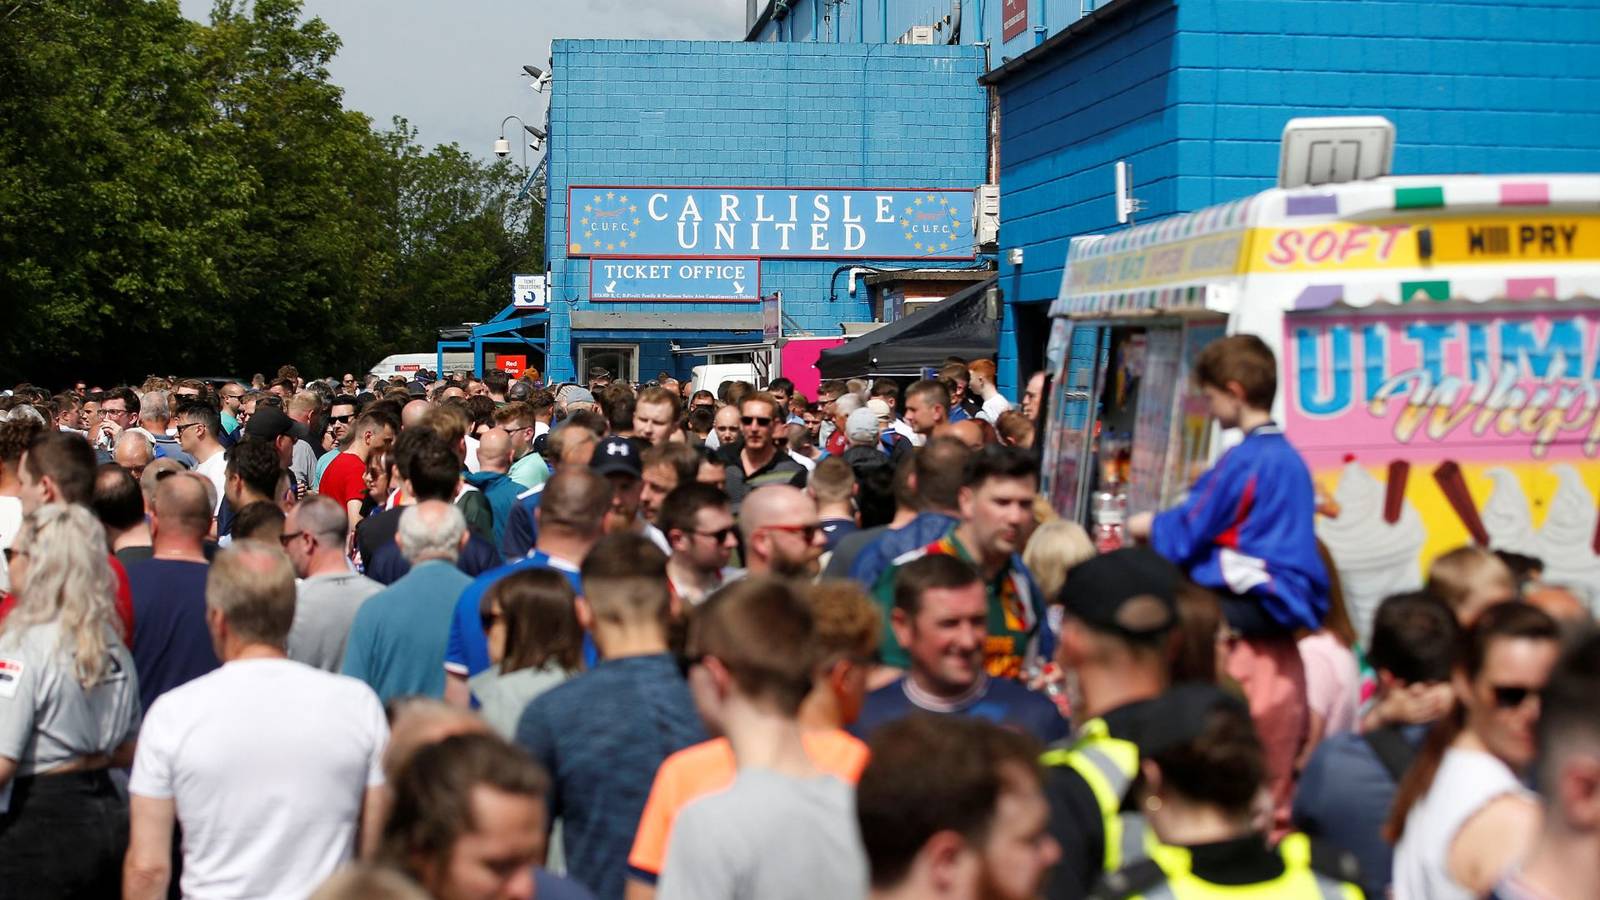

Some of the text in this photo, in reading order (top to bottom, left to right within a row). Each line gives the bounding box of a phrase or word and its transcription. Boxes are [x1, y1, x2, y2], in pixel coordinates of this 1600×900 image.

[647, 192, 895, 224] CARLISLE
[676, 221, 867, 251] UNITED
[1267, 224, 1411, 265] SOFT
[1518, 225, 1578, 255] PRY
[604, 264, 746, 280] TICKET OFFICE
[1293, 316, 1600, 420] ULTIM
